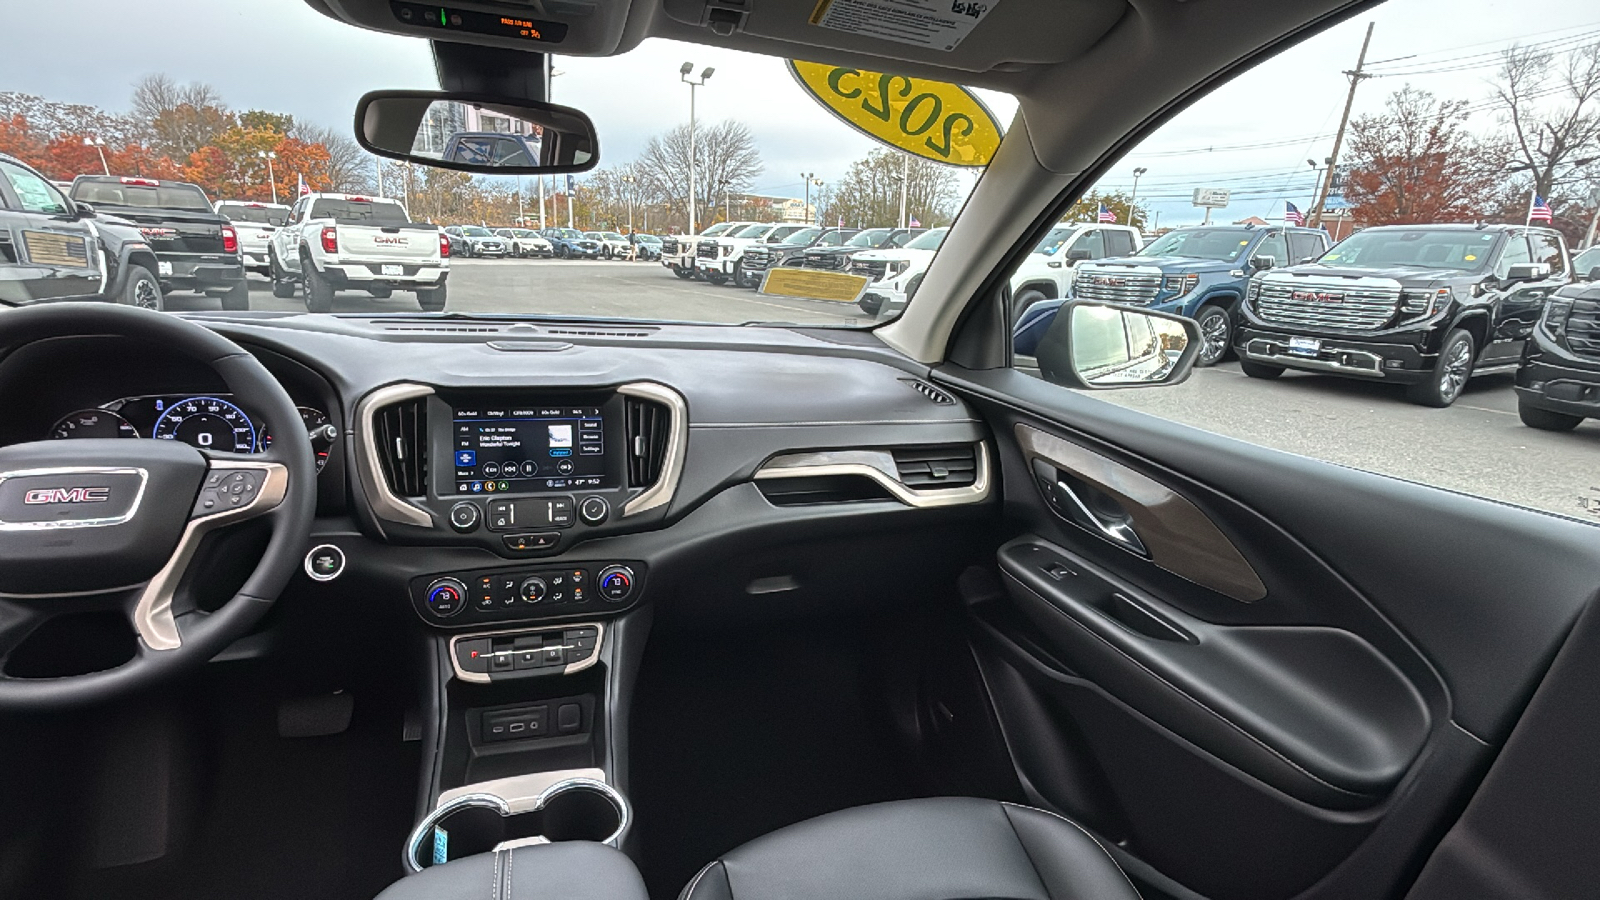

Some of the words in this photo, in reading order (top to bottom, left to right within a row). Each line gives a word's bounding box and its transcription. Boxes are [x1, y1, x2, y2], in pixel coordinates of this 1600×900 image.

[374, 236, 409, 244] GMC
[1292, 291, 1344, 303] GMC
[198, 433, 213, 446] 0
[24, 487, 109, 504] GMC
